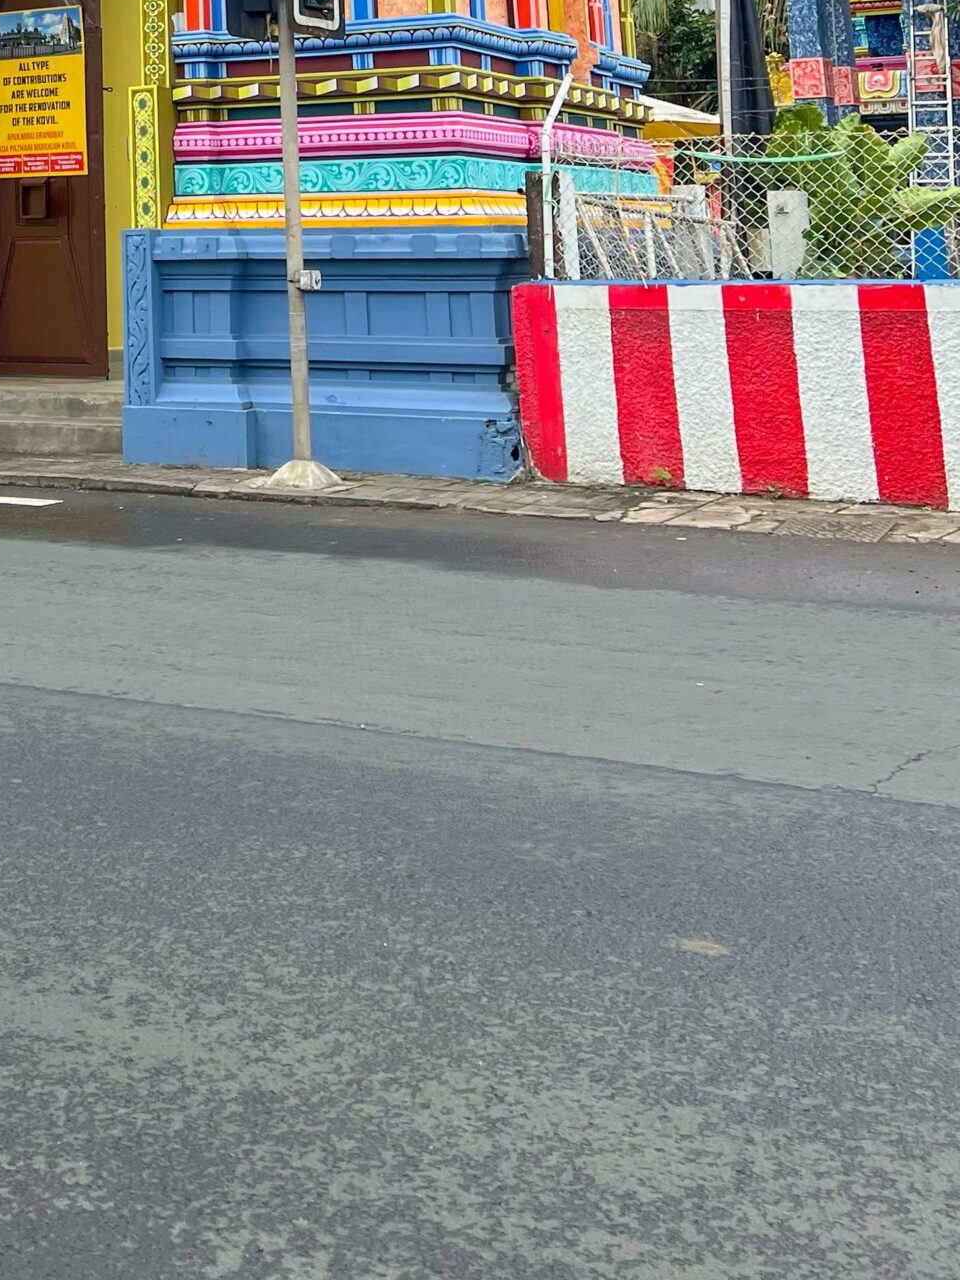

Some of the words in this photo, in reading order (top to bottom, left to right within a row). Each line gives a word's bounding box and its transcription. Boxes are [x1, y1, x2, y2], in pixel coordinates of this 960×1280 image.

[19, 62, 30, 71] ALL
[32, 61, 49, 70] TYPE
[3, 77, 11, 86] OF
[13, 73, 66, 85] CONTRIBUTIONS
[11, 90, 24, 99] ARE
[26, 88, 58, 98] WELCOME
[0, 104, 13, 113] FOR
[15, 103, 27, 112] THE
[29, 101, 70, 112] RENOVATION
[12, 117, 20, 126] OF
[22, 117, 34, 126] THE
